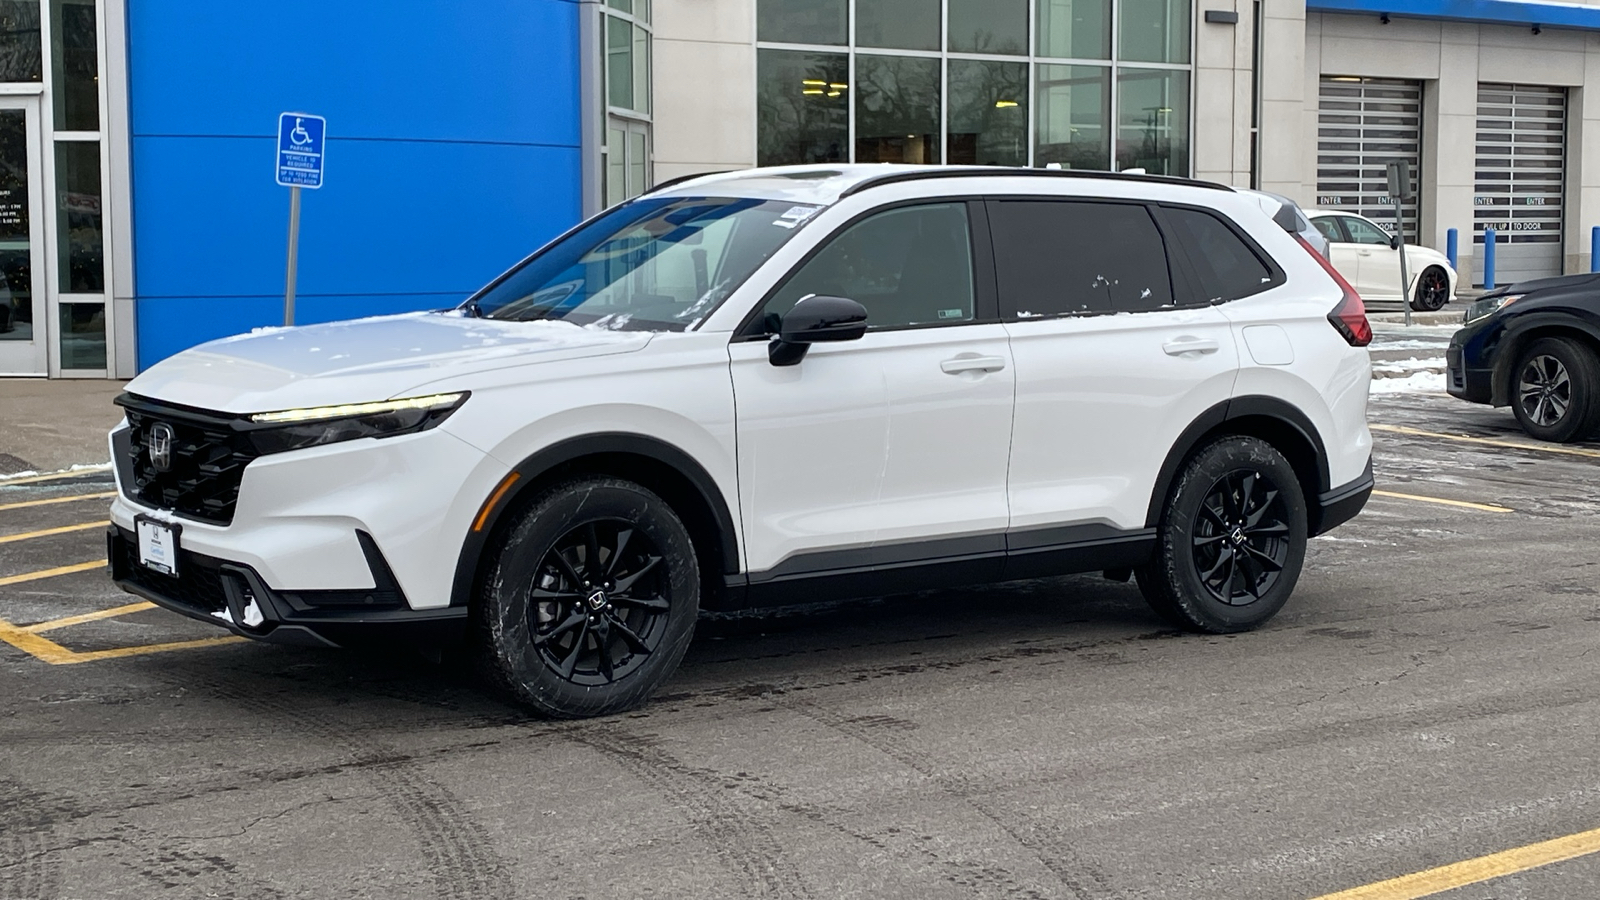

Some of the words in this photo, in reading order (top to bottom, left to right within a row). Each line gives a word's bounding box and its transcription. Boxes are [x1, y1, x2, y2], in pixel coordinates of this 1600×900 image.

[290, 144, 313, 152] PARKING
[287, 161, 313, 169] REQUIRED
[1321, 196, 1342, 204] ENTER
[1378, 197, 1397, 205] ENTE
[1474, 197, 1494, 205] ENTER
[1526, 197, 1545, 205] ENTER
[1483, 222, 1497, 231] PULL
[1499, 222, 1507, 230] UP
[1513, 222, 1522, 230] TO
[1523, 222, 1541, 230] DOOR
